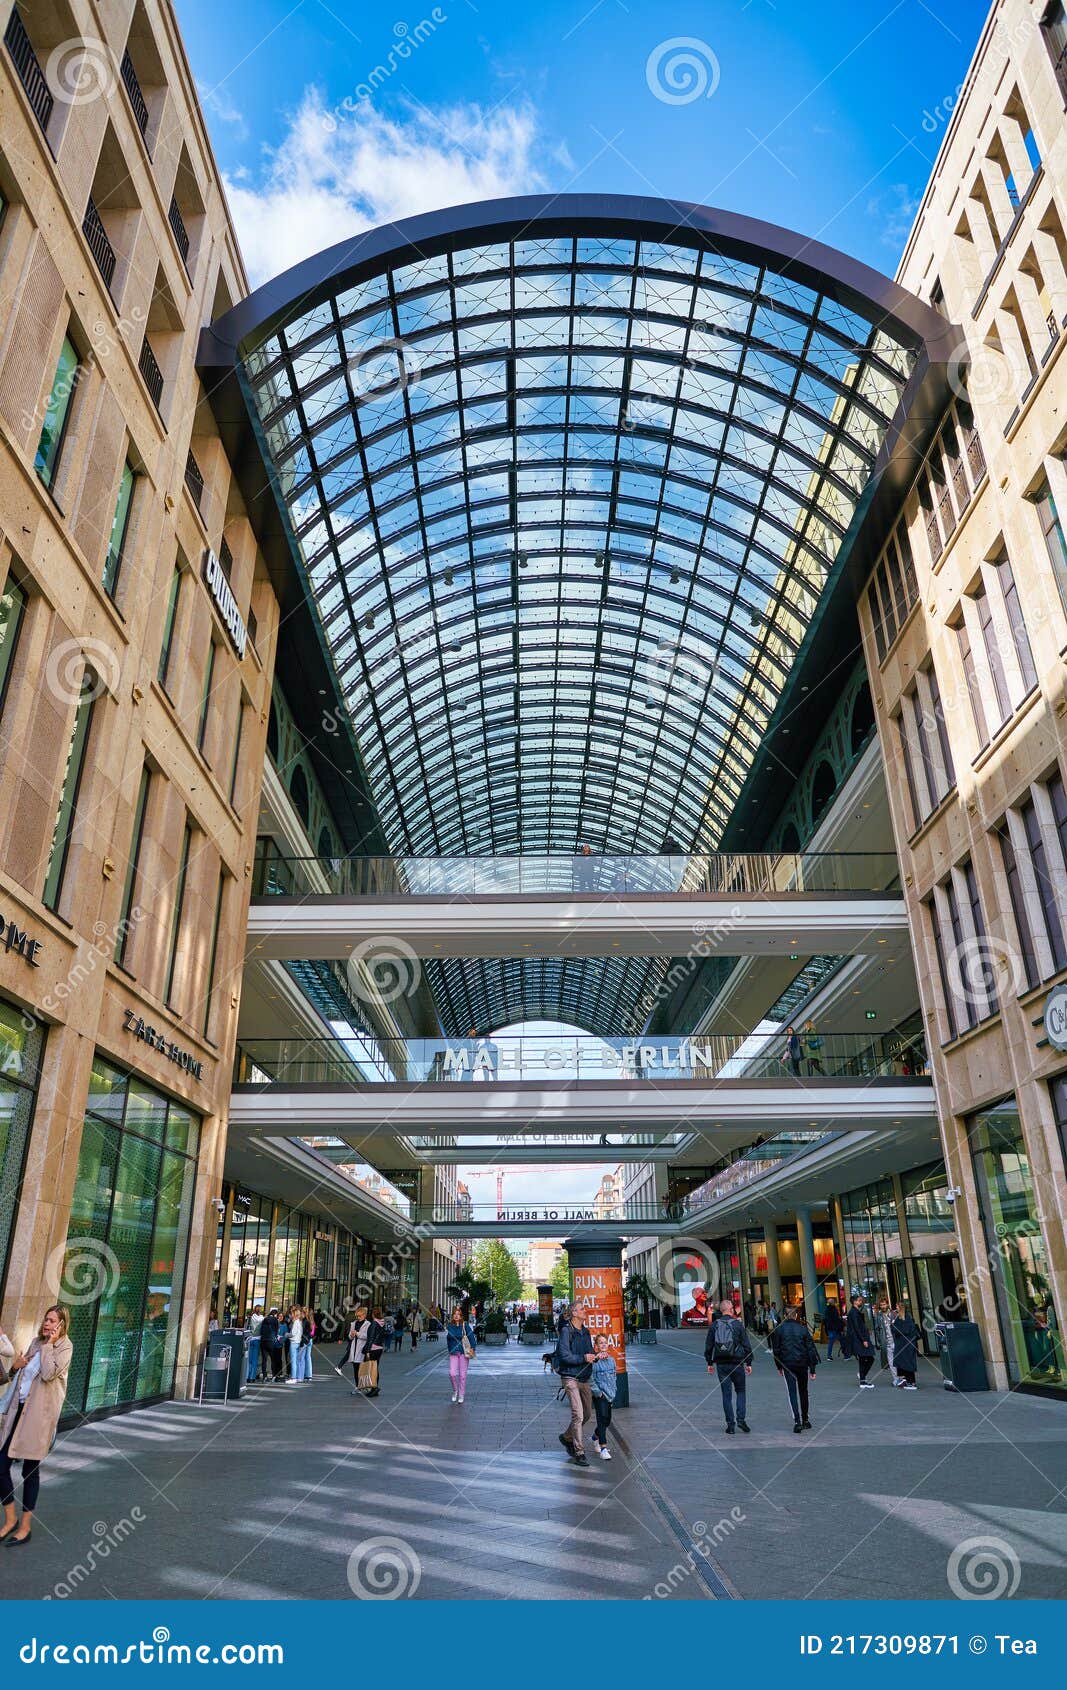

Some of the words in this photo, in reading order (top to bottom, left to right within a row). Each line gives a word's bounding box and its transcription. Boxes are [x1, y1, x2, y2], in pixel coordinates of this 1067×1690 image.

[1050, 1000, 1067, 1035] C&
[123, 1008, 165, 1054] ZARA
[167, 1042, 204, 1081] HOME
[443, 1047, 527, 1070] MALL
[543, 1047, 584, 1070] OF
[600, 1046, 713, 1069] BERLIN
[575, 1275, 606, 1289] RUN.
[583, 1314, 612, 1328] LEEP.
